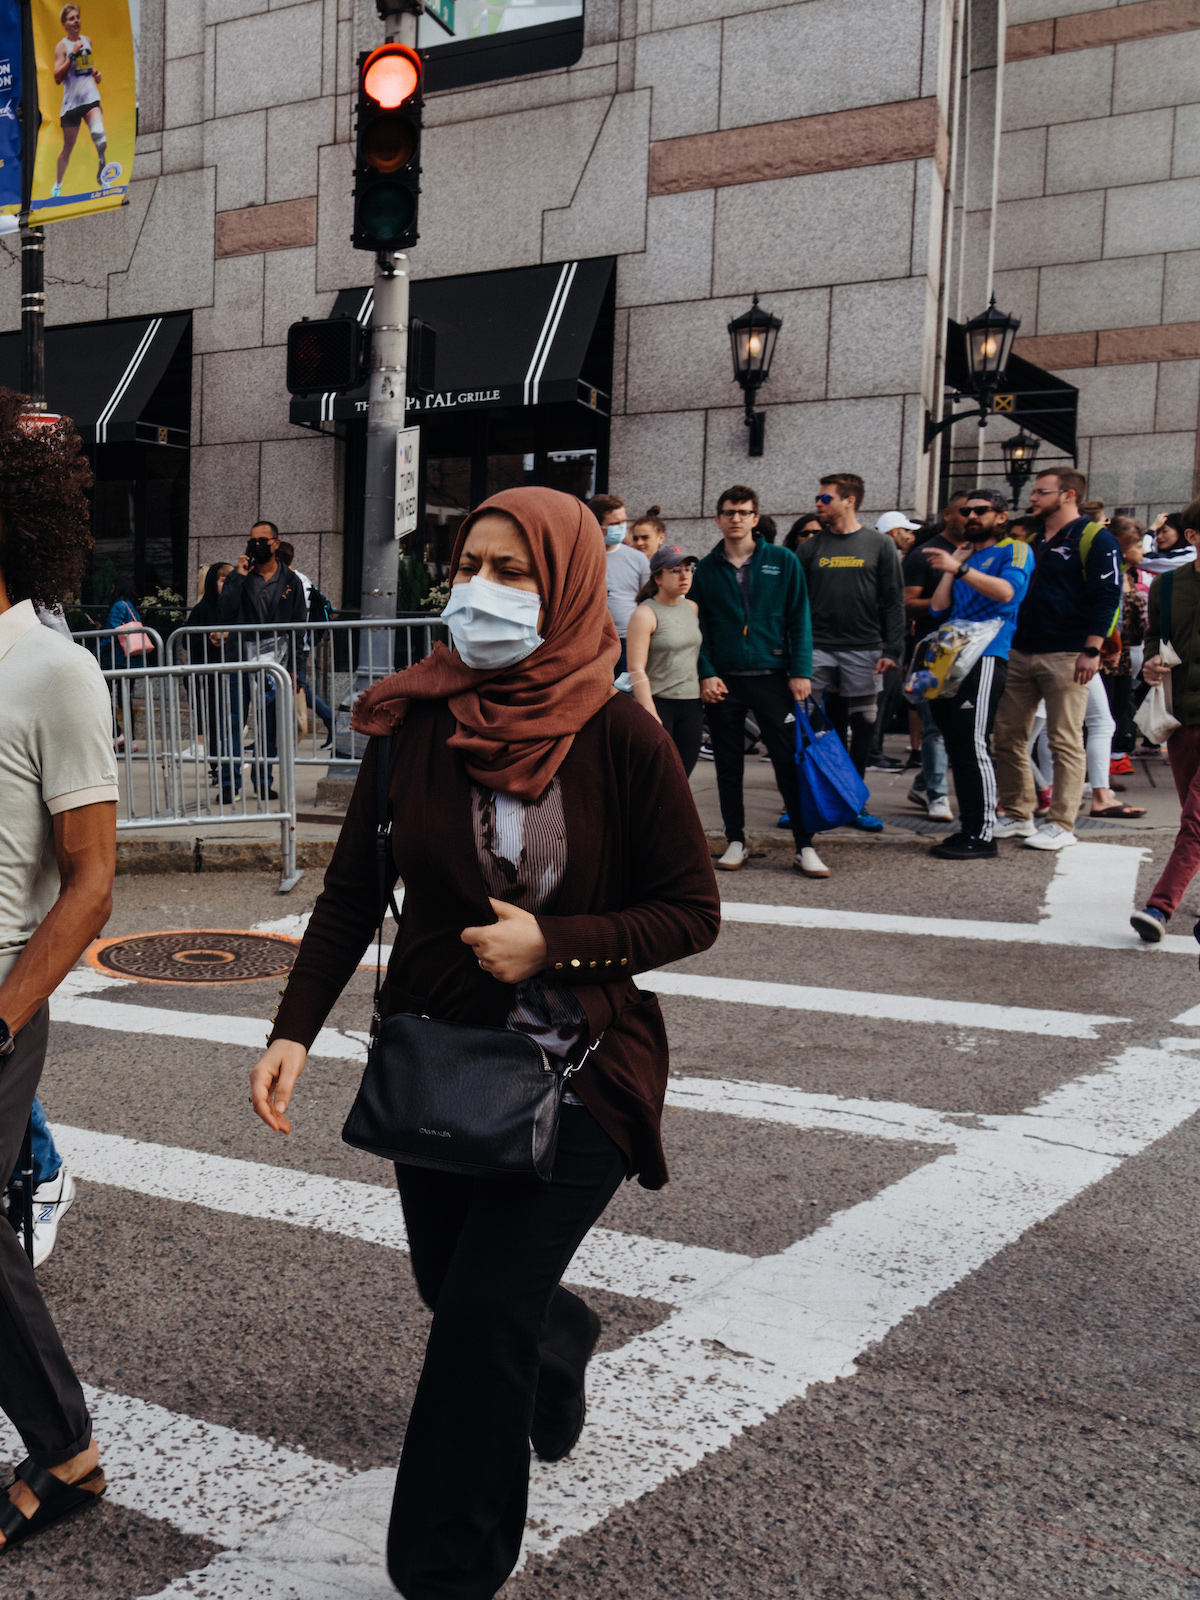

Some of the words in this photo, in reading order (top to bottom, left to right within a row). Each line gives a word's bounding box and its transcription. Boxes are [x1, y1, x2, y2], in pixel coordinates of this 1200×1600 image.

[355, 401, 370, 412] TH
[405, 392, 457, 411] PITAL
[457, 390, 501, 404] GRILLE
